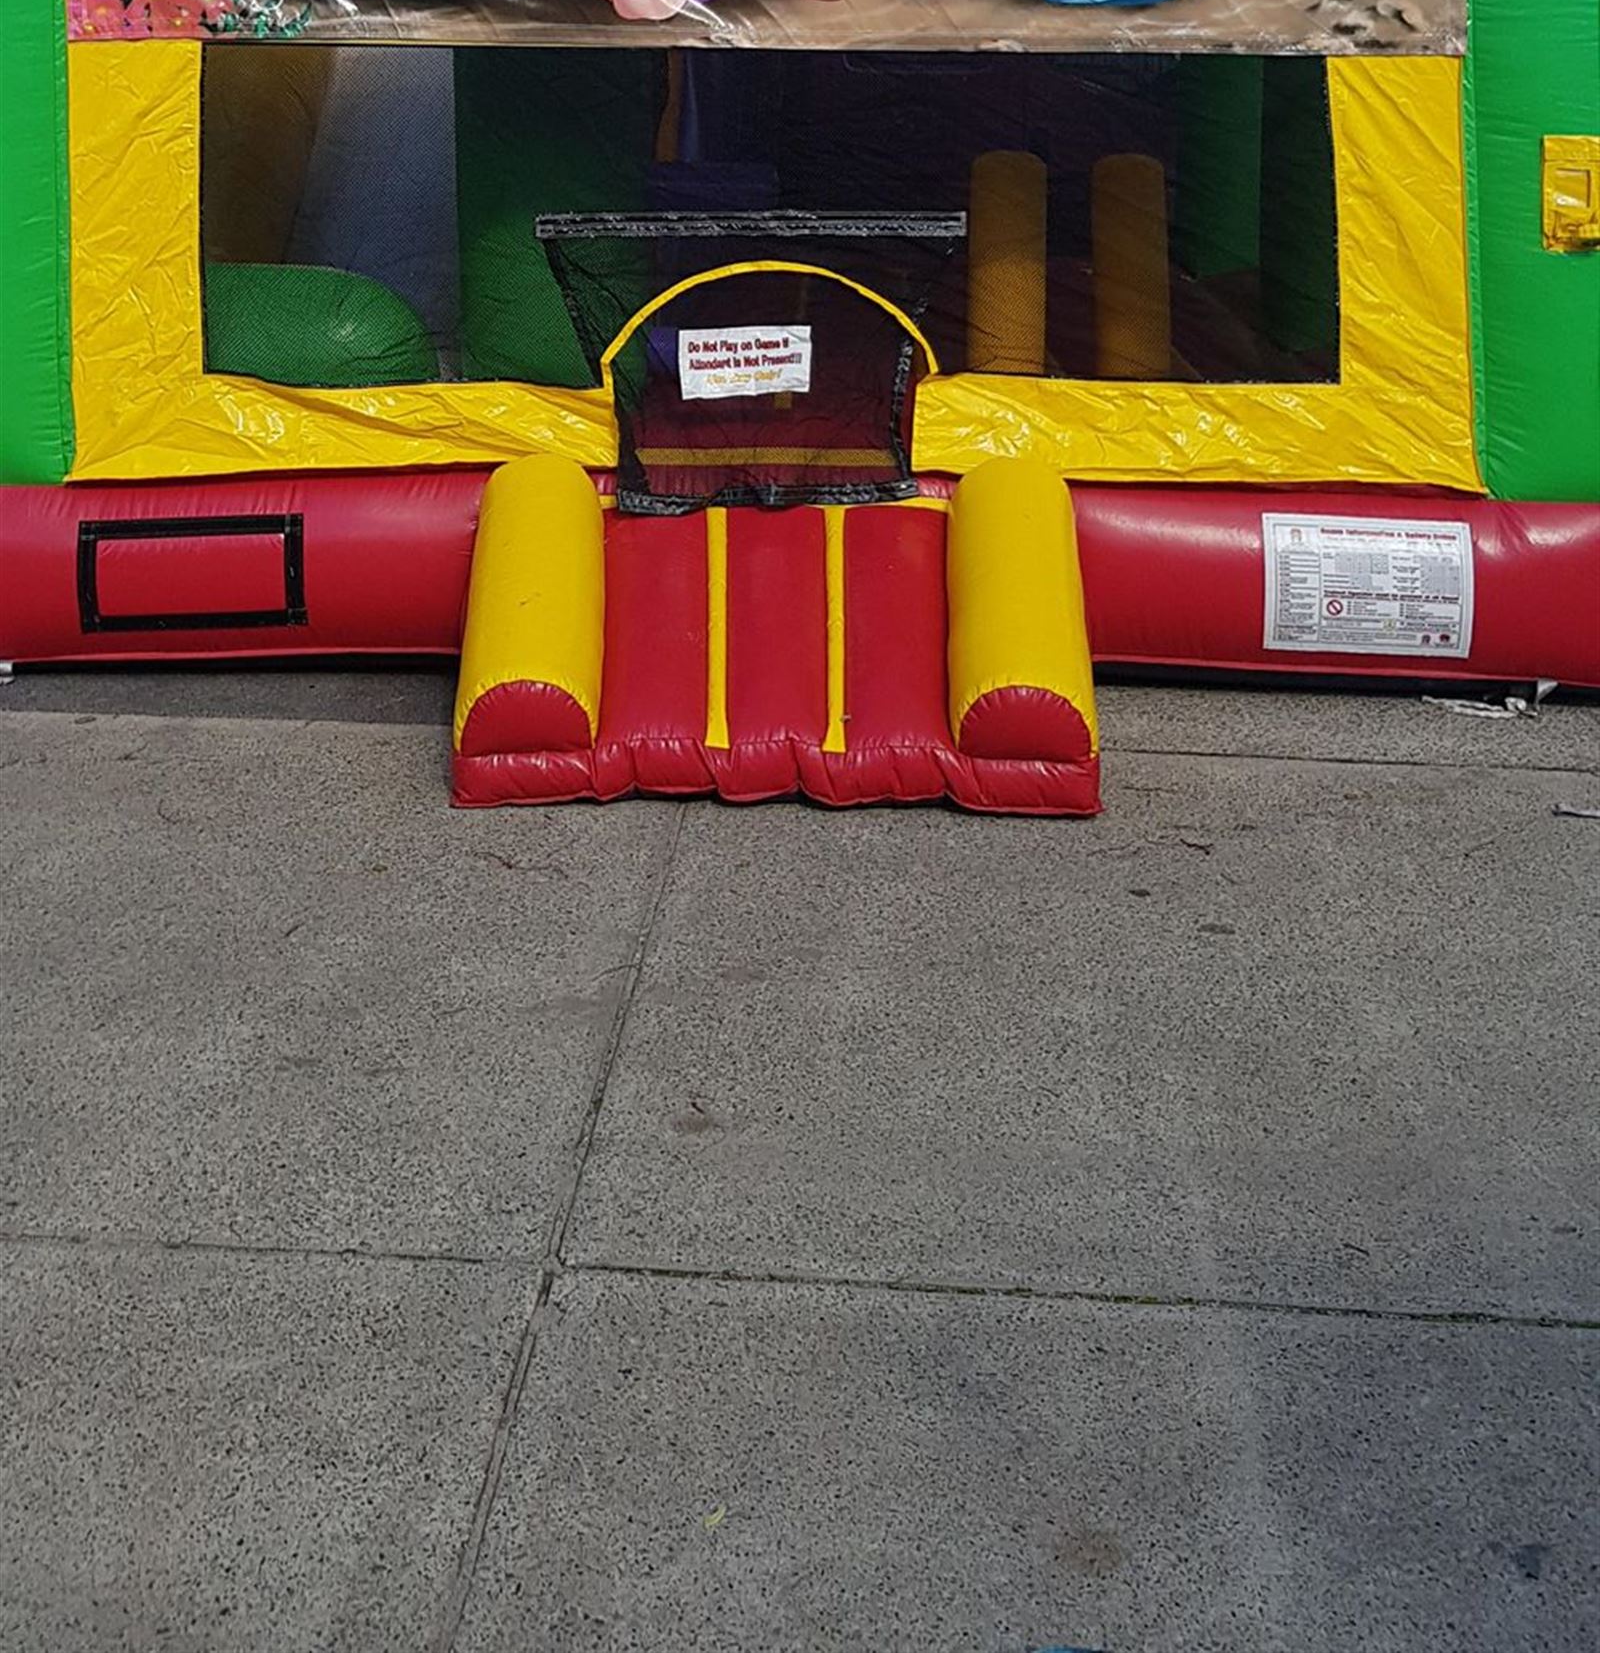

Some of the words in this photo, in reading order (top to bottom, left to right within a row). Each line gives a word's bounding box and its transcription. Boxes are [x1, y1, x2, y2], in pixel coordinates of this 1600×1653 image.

[688, 341, 700, 353] Do
[702, 340, 718, 353] Not
[719, 339, 738, 354] Play
[740, 340, 752, 351] on
[754, 337, 780, 350] Game
[743, 355, 759, 367] Not
